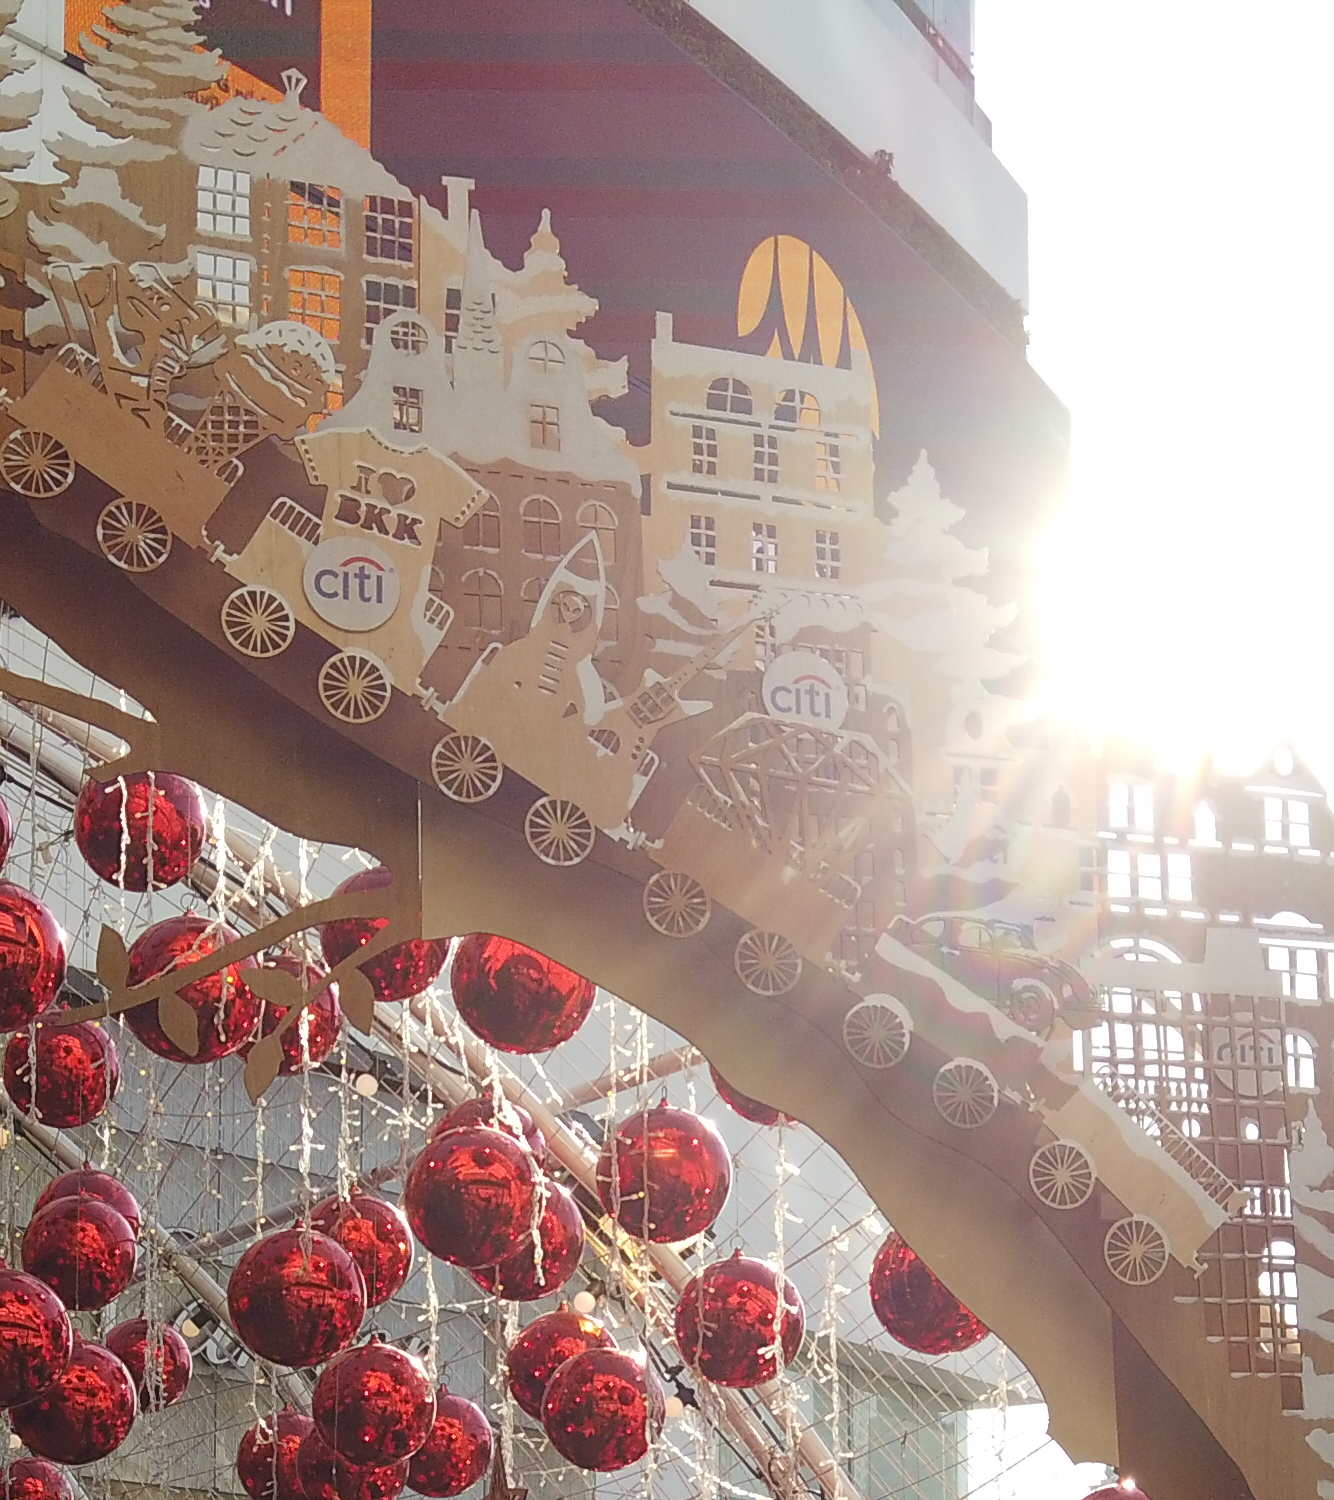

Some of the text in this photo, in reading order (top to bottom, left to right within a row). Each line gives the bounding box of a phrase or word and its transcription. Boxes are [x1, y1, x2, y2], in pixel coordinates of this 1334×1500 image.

[350, 463, 377, 495] I
[334, 493, 424, 547] BKK
[314, 564, 384, 605] citi
[770, 682, 831, 719] citi
